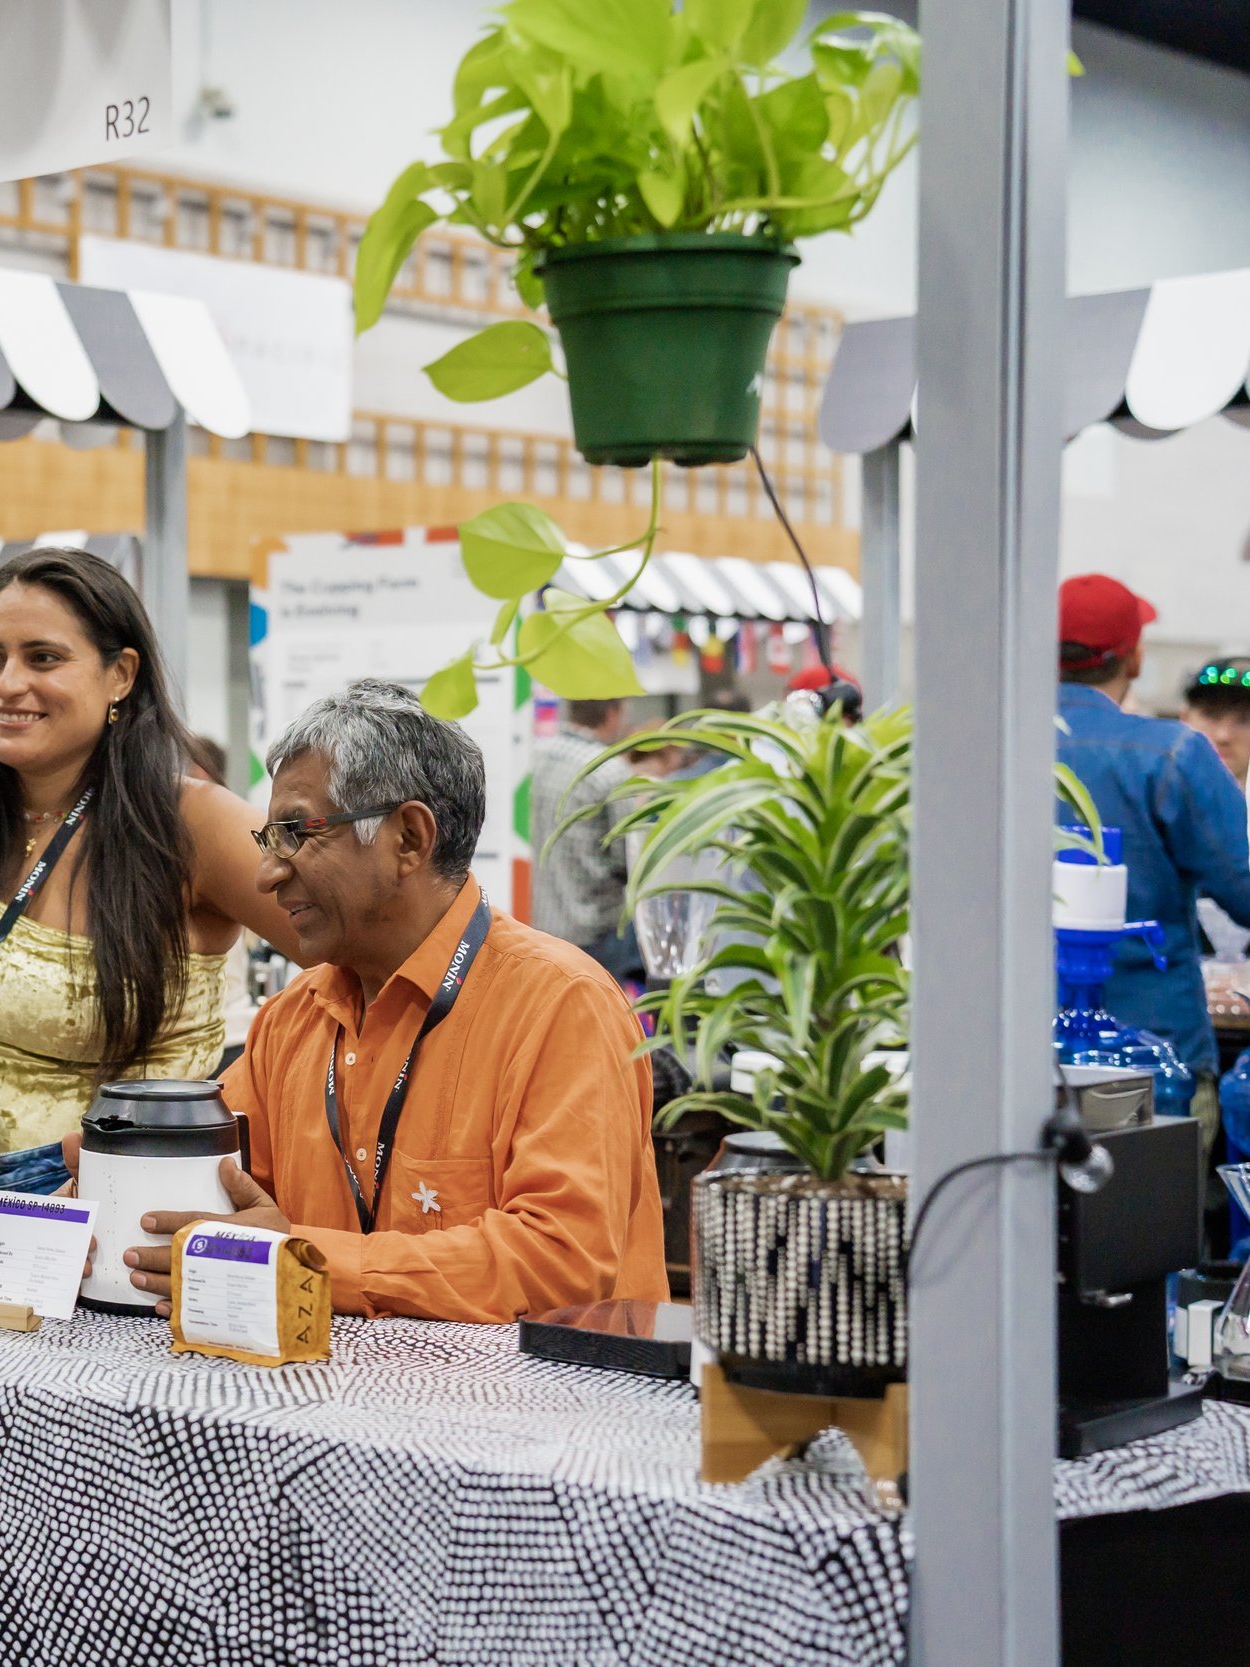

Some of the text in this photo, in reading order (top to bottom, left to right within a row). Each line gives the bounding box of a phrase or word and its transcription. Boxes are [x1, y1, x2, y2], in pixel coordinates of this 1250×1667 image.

[105, 96, 151, 141] R32
[15, 861, 47, 902] MONIN
[444, 940, 471, 993] MONIN
